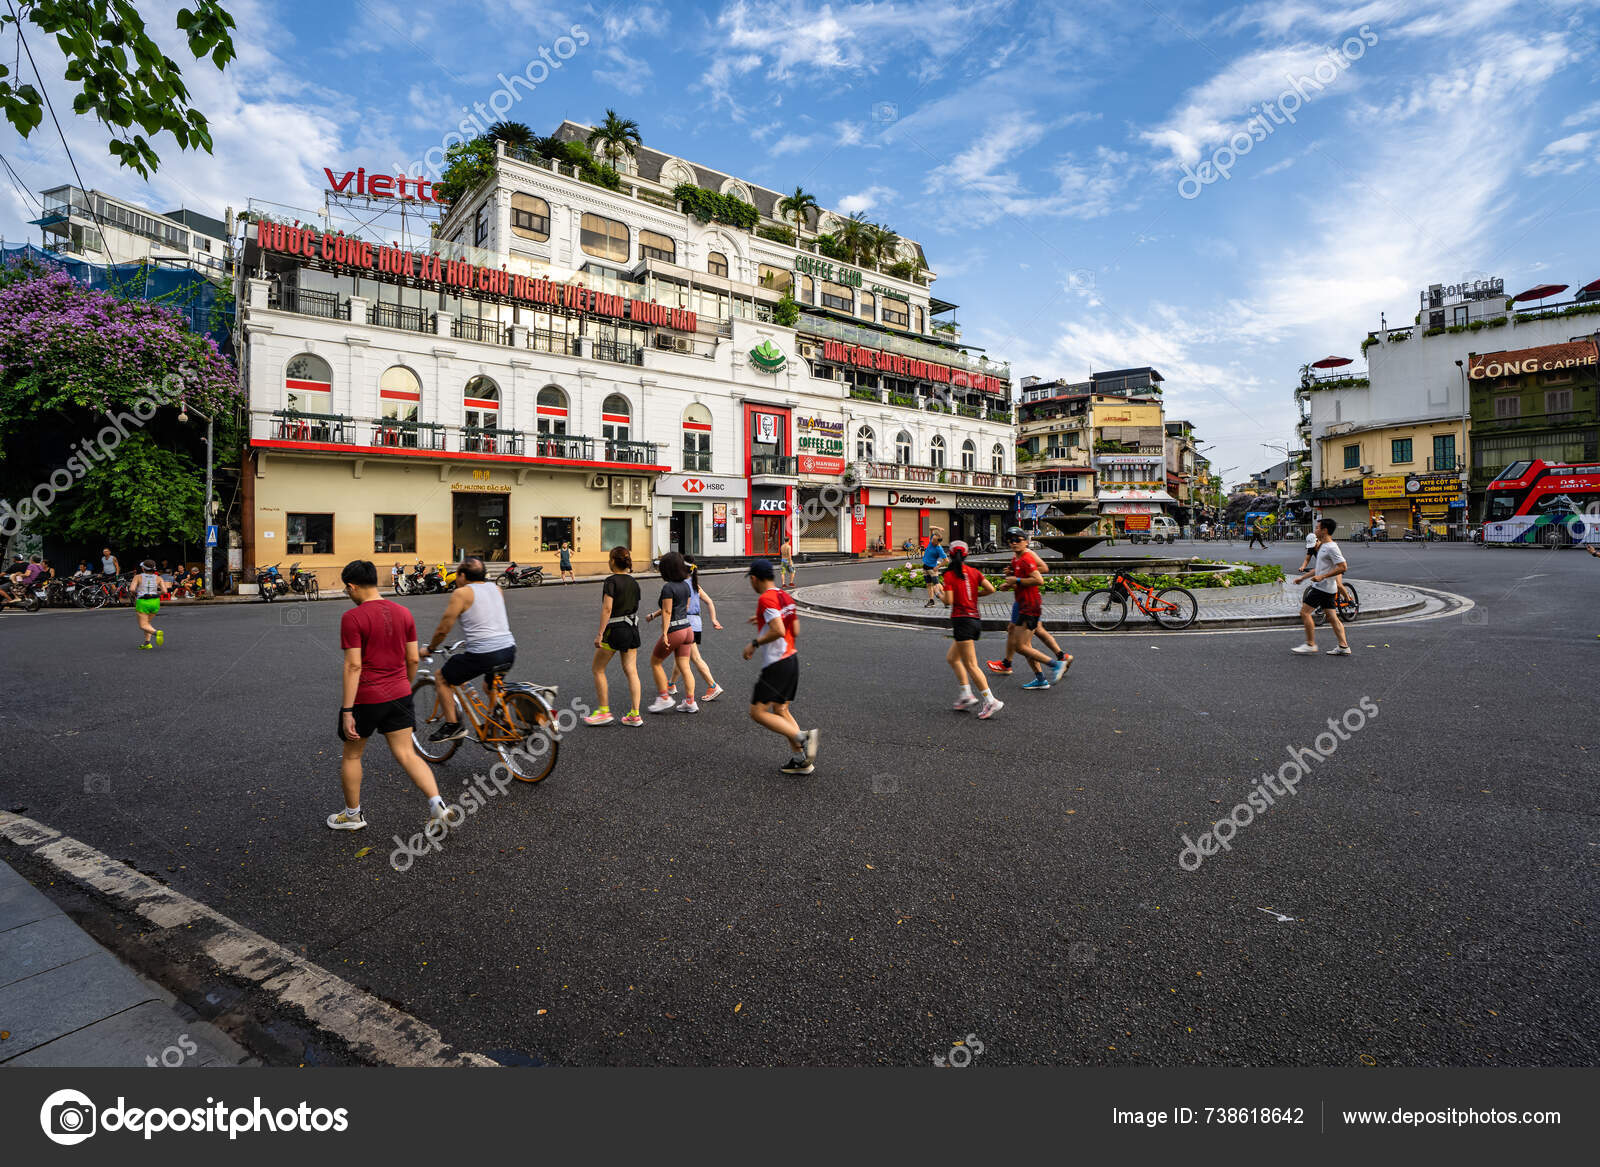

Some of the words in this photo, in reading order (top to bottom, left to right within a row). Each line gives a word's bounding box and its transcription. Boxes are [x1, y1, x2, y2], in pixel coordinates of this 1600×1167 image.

[257, 220, 315, 258] NƯỚC
[321, 229, 372, 269] CỘNG
[378, 241, 414, 277] HÒA
[419, 251, 443, 283] XÃ
[446, 256, 474, 293] HỘI
[479, 264, 509, 296] CHỦ
[513, 274, 559, 306] NGHĨA
[563, 282, 592, 315] VIỆT
[594, 291, 624, 319] NAM
[629, 298, 667, 327] MUÔN
[671, 304, 697, 333] NĂM
[795, 255, 834, 280] COFFEE
[839, 267, 862, 288] CLUB
[823, 337, 848, 363] ĐẢNG
[850, 344, 873, 368] CỘNG
[875, 348, 892, 371] SẢN
[893, 353, 908, 377] VIỆT
[910, 359, 927, 379] NAM
[1469, 358, 1539, 380] CỘNG
[799, 436, 825, 449] COFFEE
[826, 439, 843, 450] CLUB
[706, 483, 725, 491] HSBC
[759, 499, 787, 511] KFC
